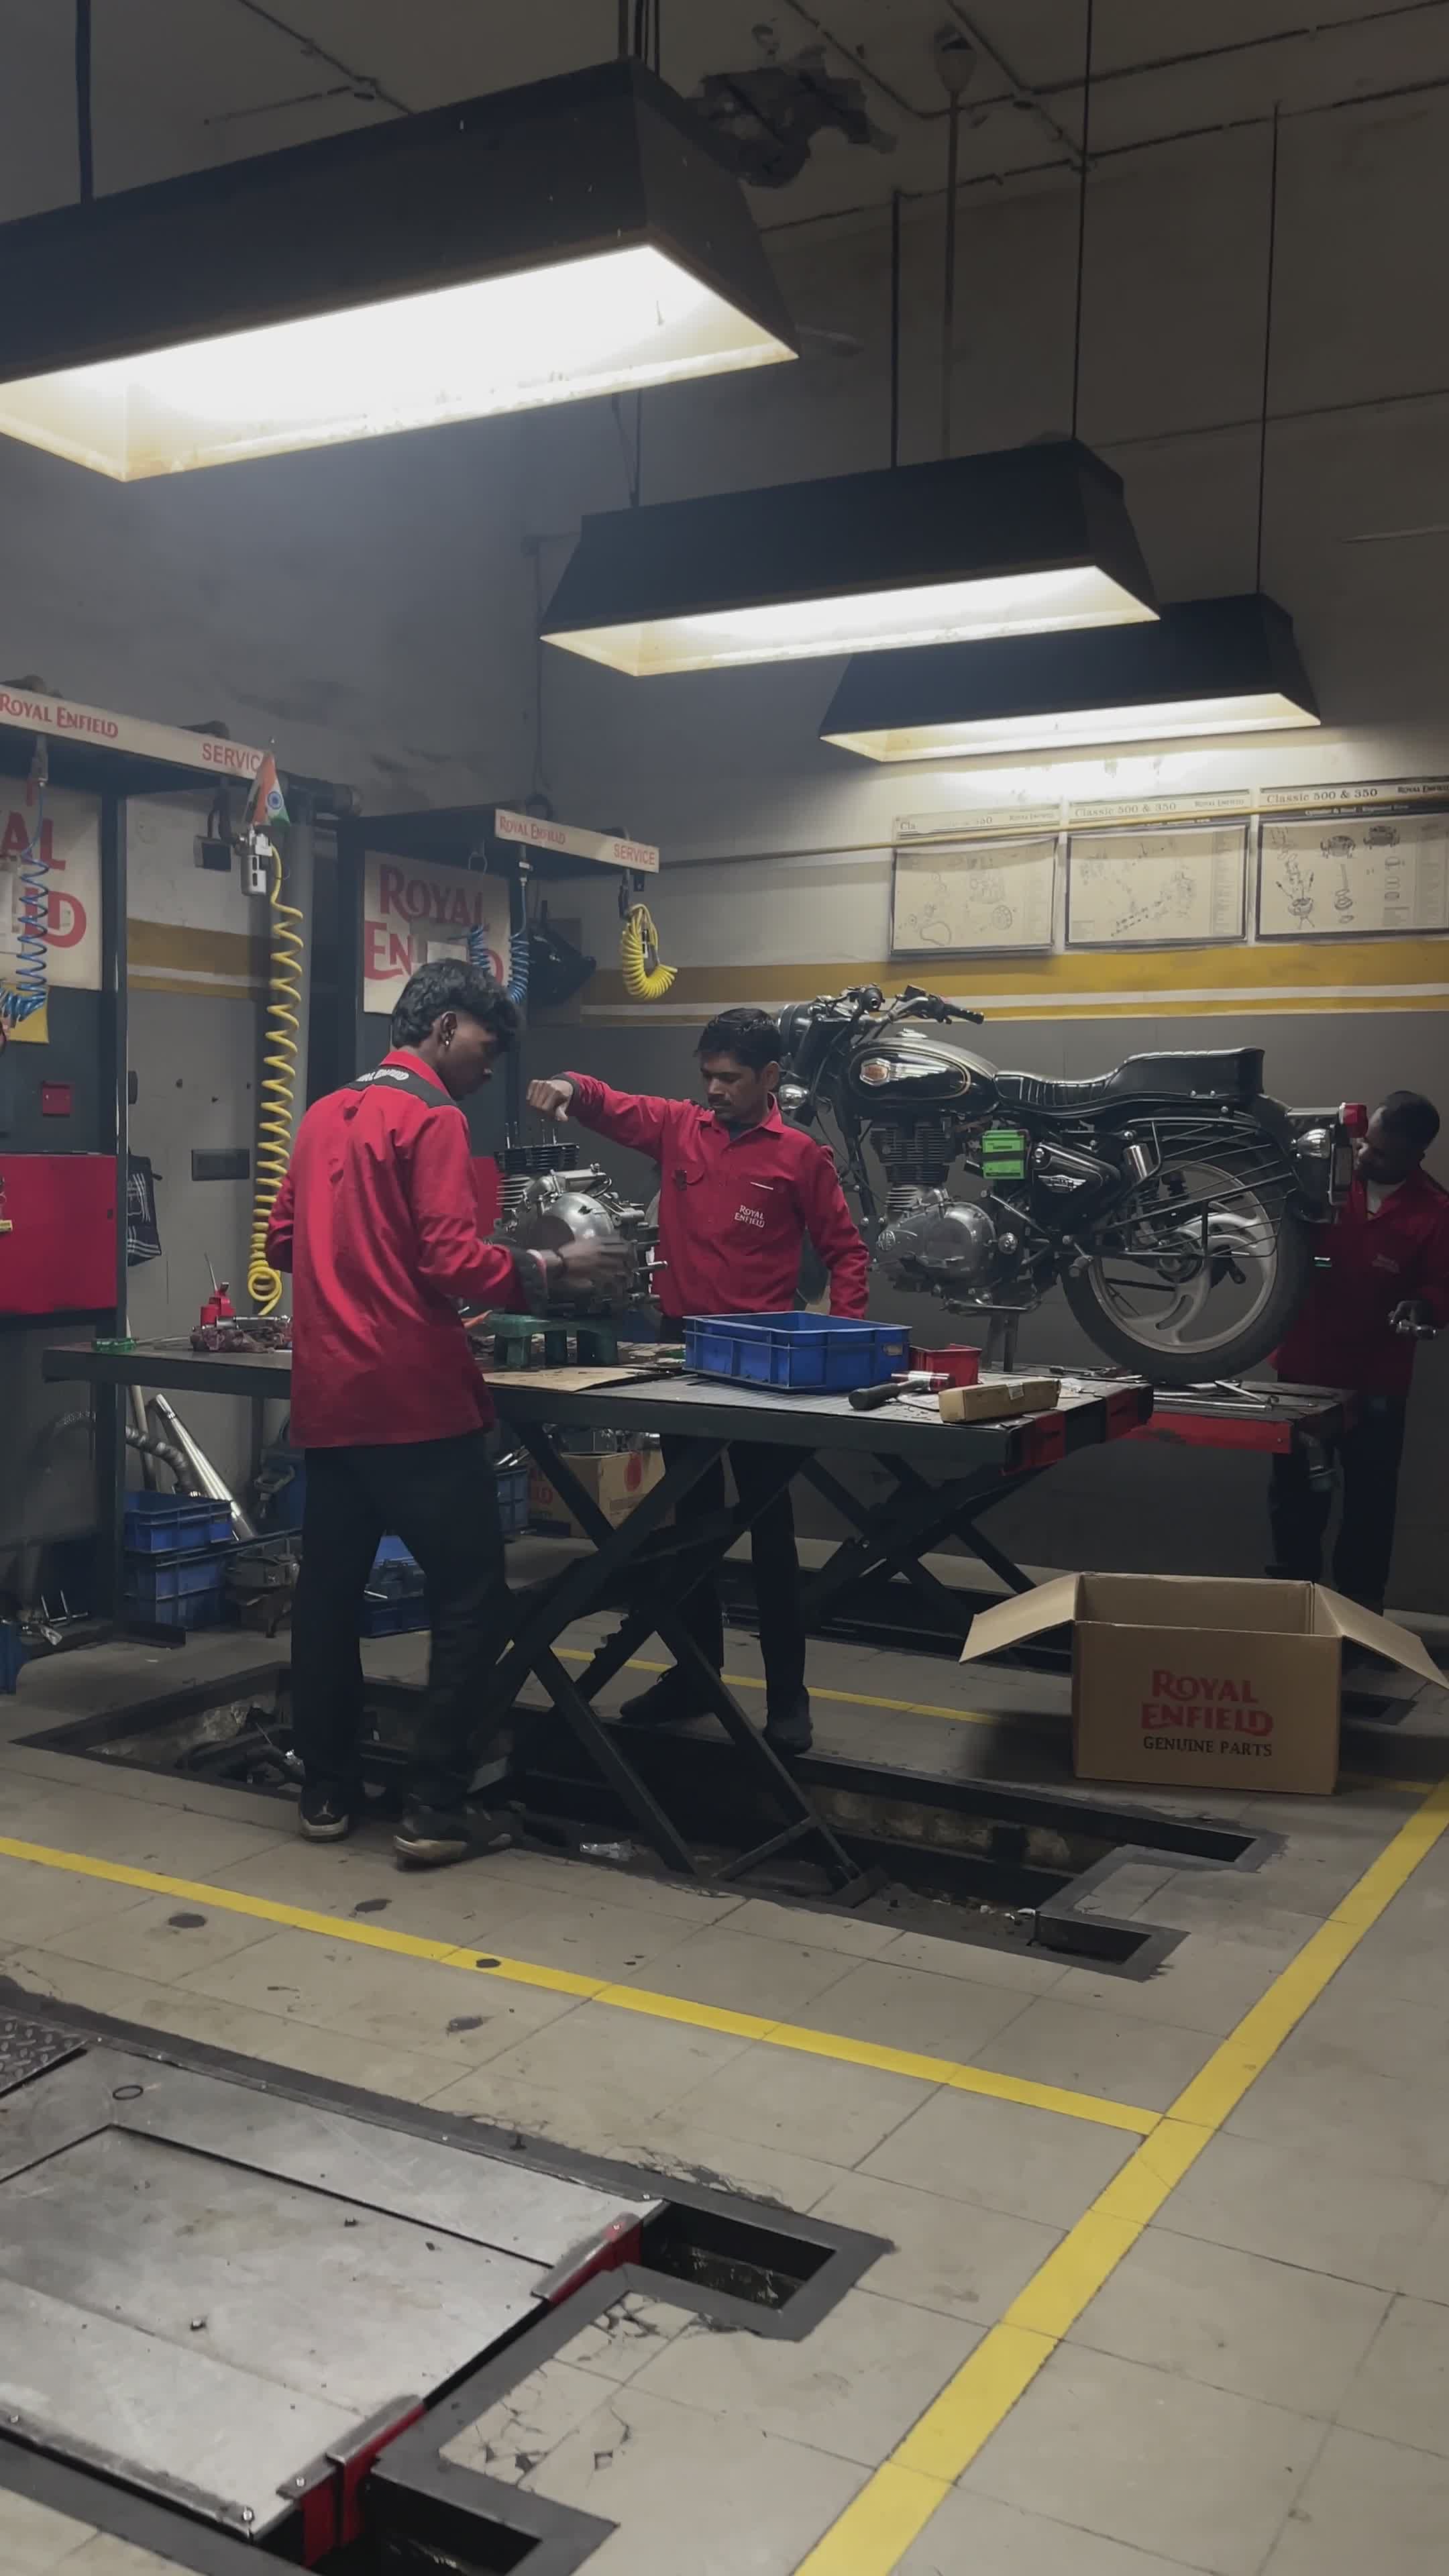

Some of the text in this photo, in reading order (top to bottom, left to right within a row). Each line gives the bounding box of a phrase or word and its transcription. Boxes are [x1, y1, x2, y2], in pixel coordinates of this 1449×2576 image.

[0, 692, 119, 739] ROYAL ENFIELD
[203, 743, 261, 772] SERVIC
[1267, 788, 1378, 804] Classic 500 & 350
[1075, 802, 1176, 817] Classic 500 & 350
[500, 815, 528, 836] ROYAL
[613, 843, 655, 865] SERVICE
[380, 864, 490, 931] ROYAL
[735, 1212, 765, 1228] ENFIELD
[739, 1204, 764, 1220] ROYAL
[1152, 1668, 1258, 1704] ROYAL
[1141, 1703, 1273, 1737] ENFIELD
[1143, 1735, 1272, 1758] GENUINE PARTS
